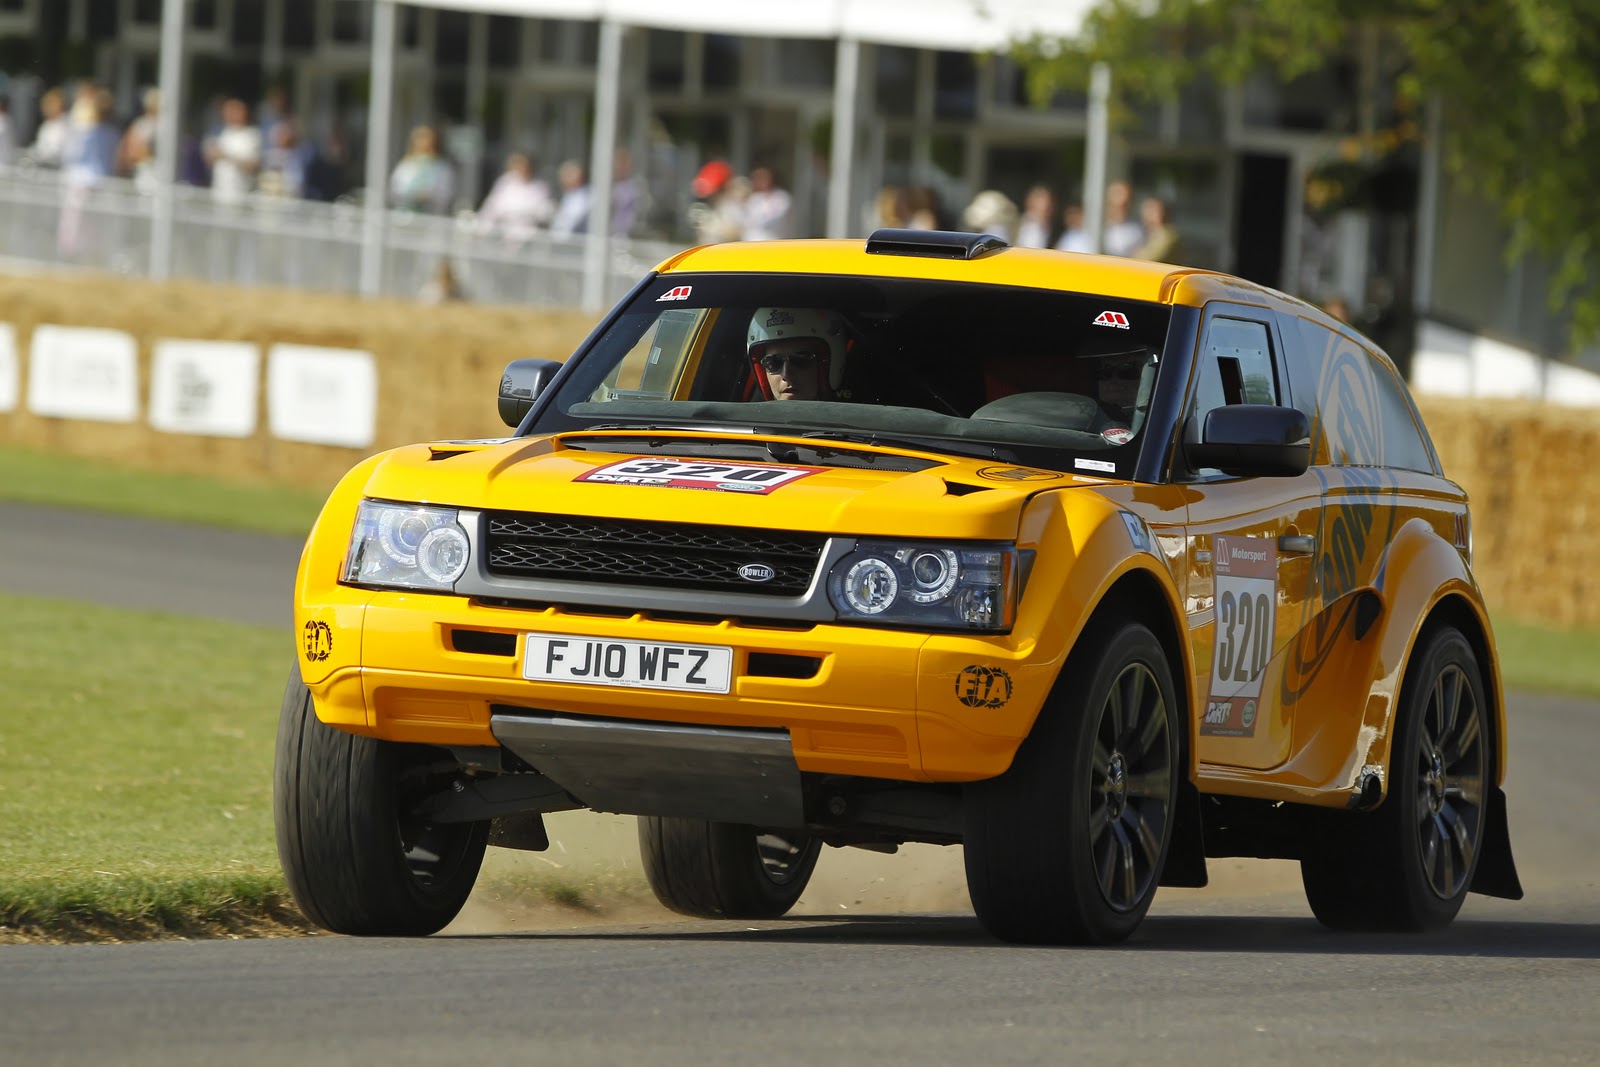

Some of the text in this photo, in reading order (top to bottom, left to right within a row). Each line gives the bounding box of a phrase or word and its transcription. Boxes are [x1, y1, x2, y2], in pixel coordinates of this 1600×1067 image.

[618, 462, 788, 481] 320
[1231, 547, 1266, 563] Motorsport
[744, 567, 769, 577] BOWLER
[1218, 590, 1270, 683] 320
[546, 640, 709, 685] FJ10 WFZ
